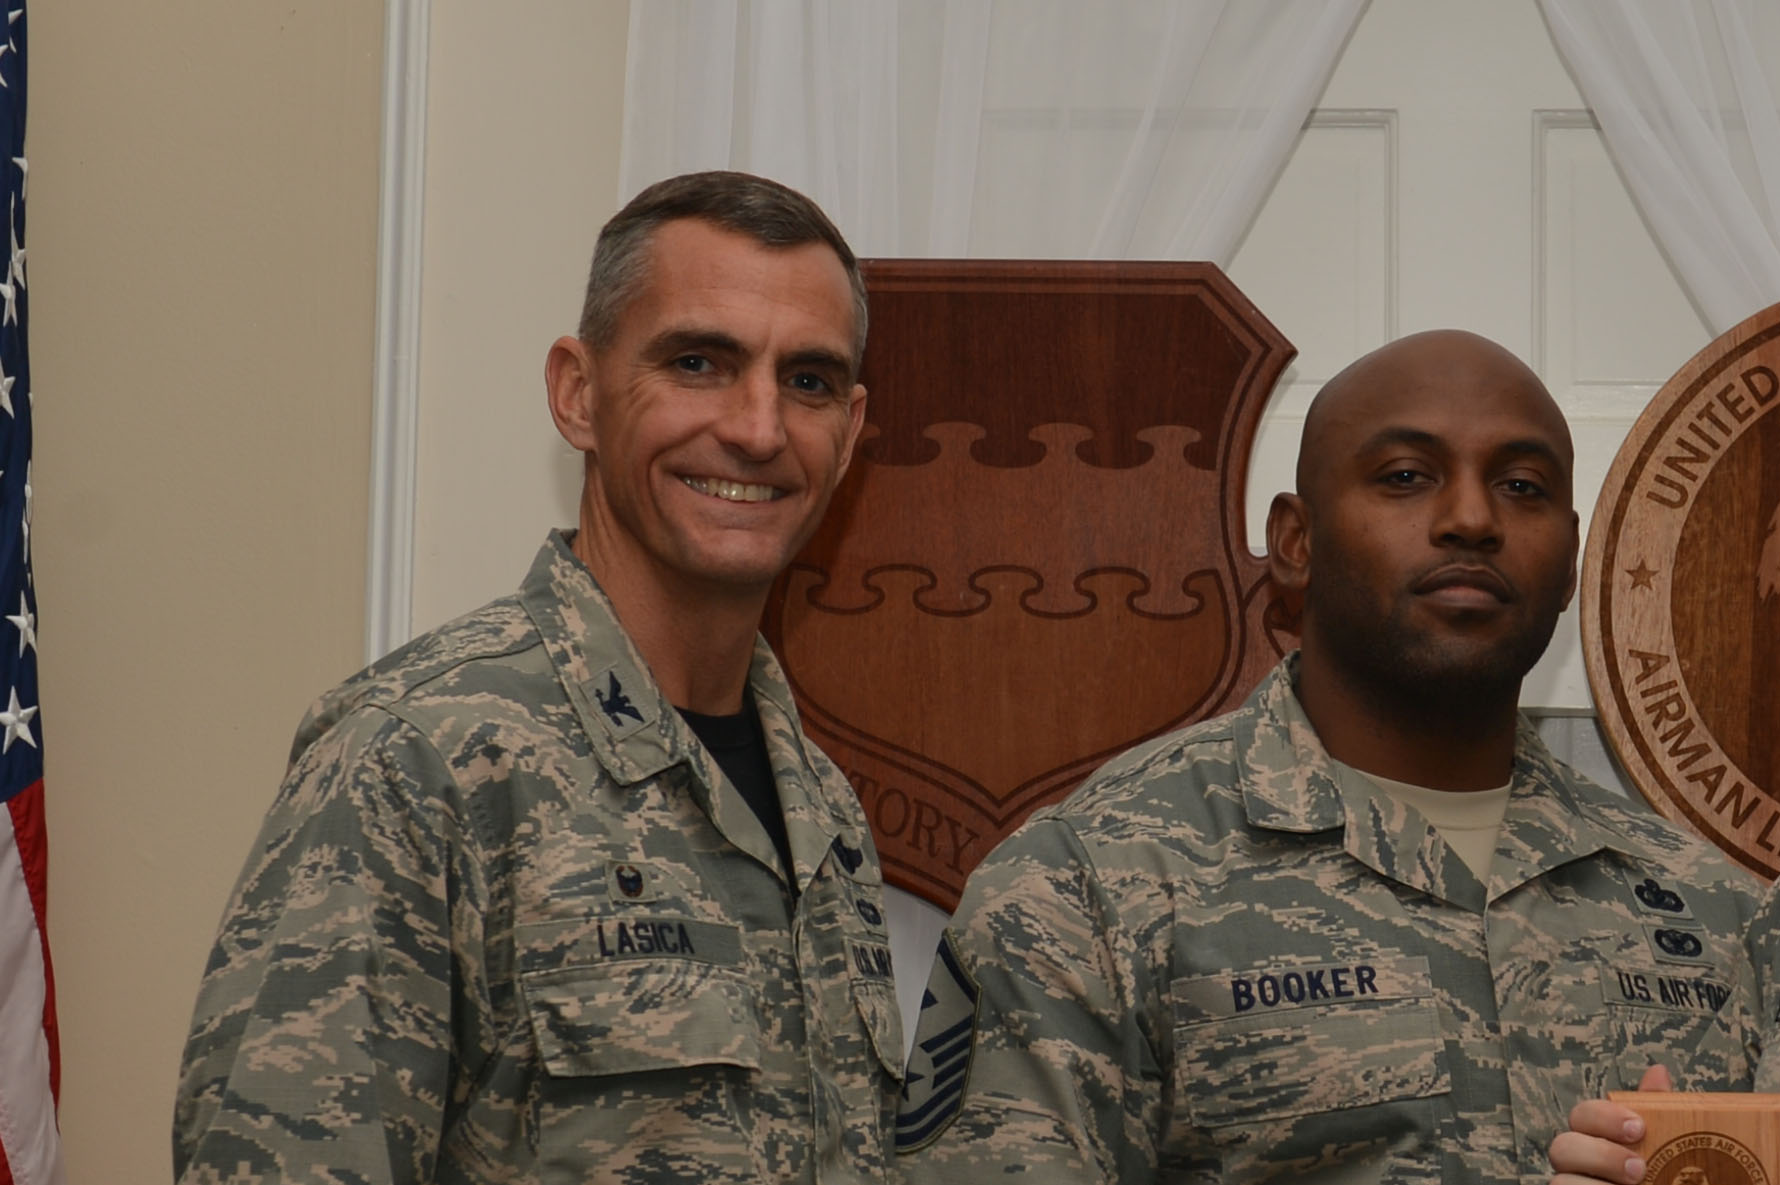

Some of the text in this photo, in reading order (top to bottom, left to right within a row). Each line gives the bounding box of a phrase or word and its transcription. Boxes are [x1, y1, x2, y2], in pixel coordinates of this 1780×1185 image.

[1646, 365, 1780, 509] UNITED
[1628, 649, 1762, 829] AIRMAN
[598, 921, 695, 957] LASICA
[1231, 965, 1379, 1013] BOOKER
[1616, 972, 1732, 1013] U.S. AIR FOR
[1646, 1136, 1764, 1185] UNITED STATES AIR FORCE
